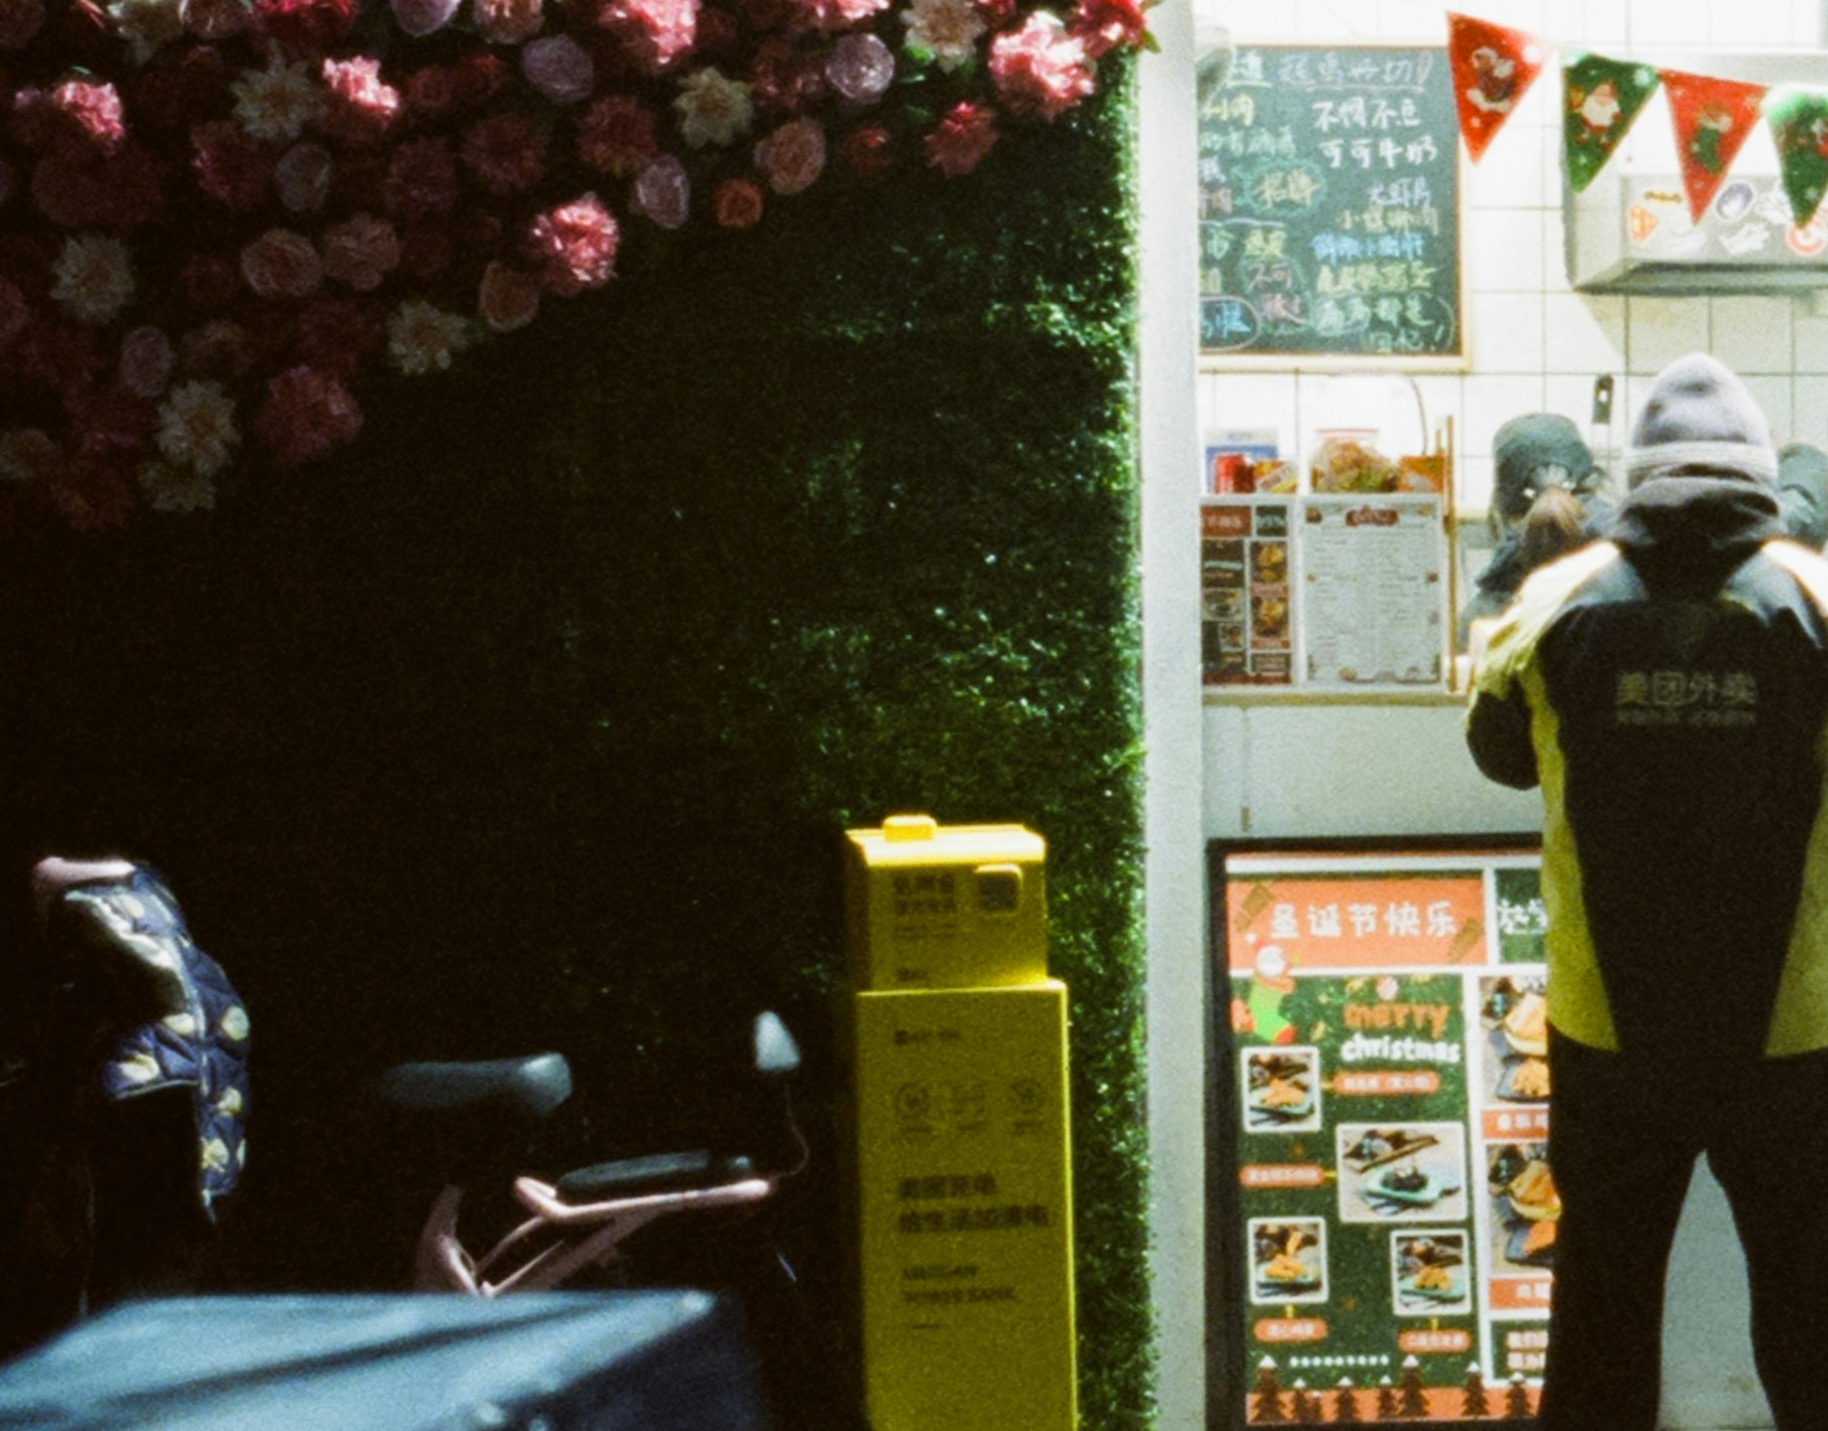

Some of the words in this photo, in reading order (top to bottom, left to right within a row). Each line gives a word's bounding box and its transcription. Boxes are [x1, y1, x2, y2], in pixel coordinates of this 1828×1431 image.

[1617, 671, 1758, 706] 美团外卖
[1271, 900, 1459, 938] 圣诞节快乐
[1340, 1031, 1461, 1065] christmas
